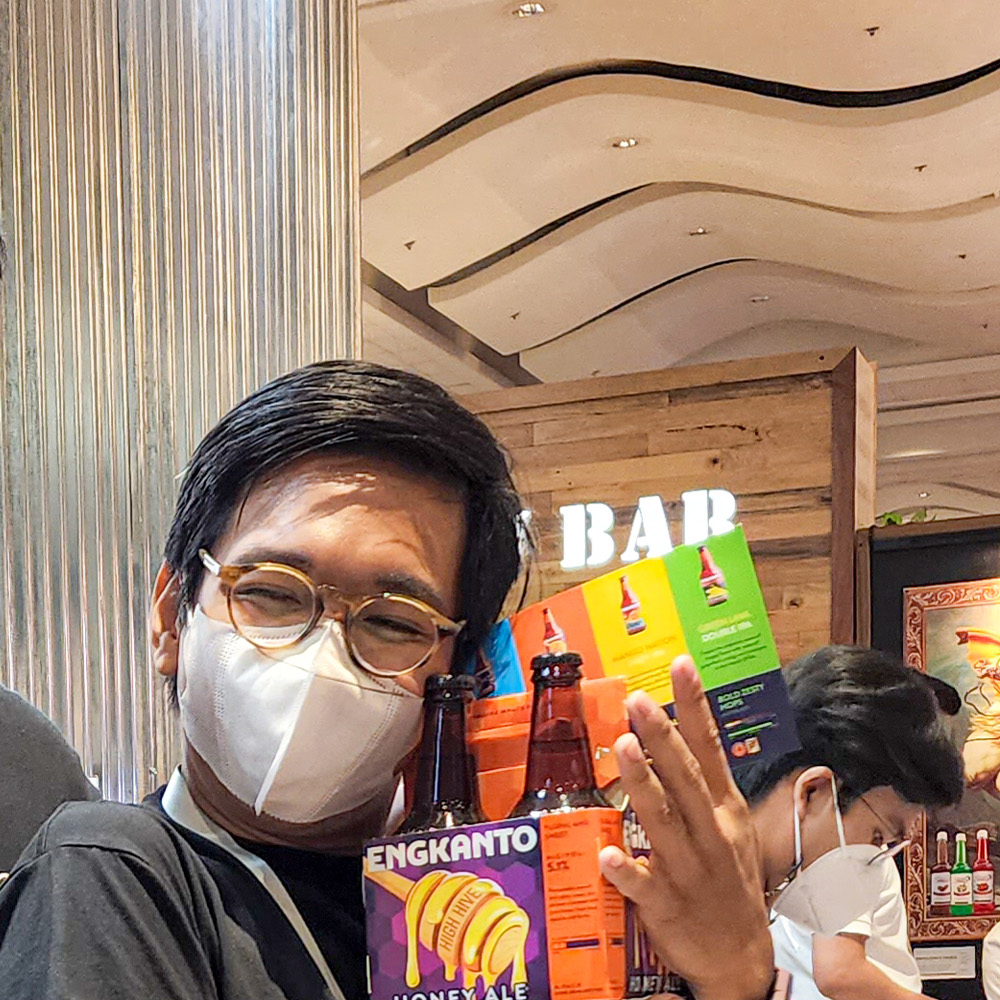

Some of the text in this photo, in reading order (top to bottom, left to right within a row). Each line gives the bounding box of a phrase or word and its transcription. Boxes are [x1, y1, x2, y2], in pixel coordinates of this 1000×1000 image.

[559, 489, 737, 570] BAR
[367, 825, 538, 872] ENGKANTO
[440, 886, 481, 952] HIGH HIVE
